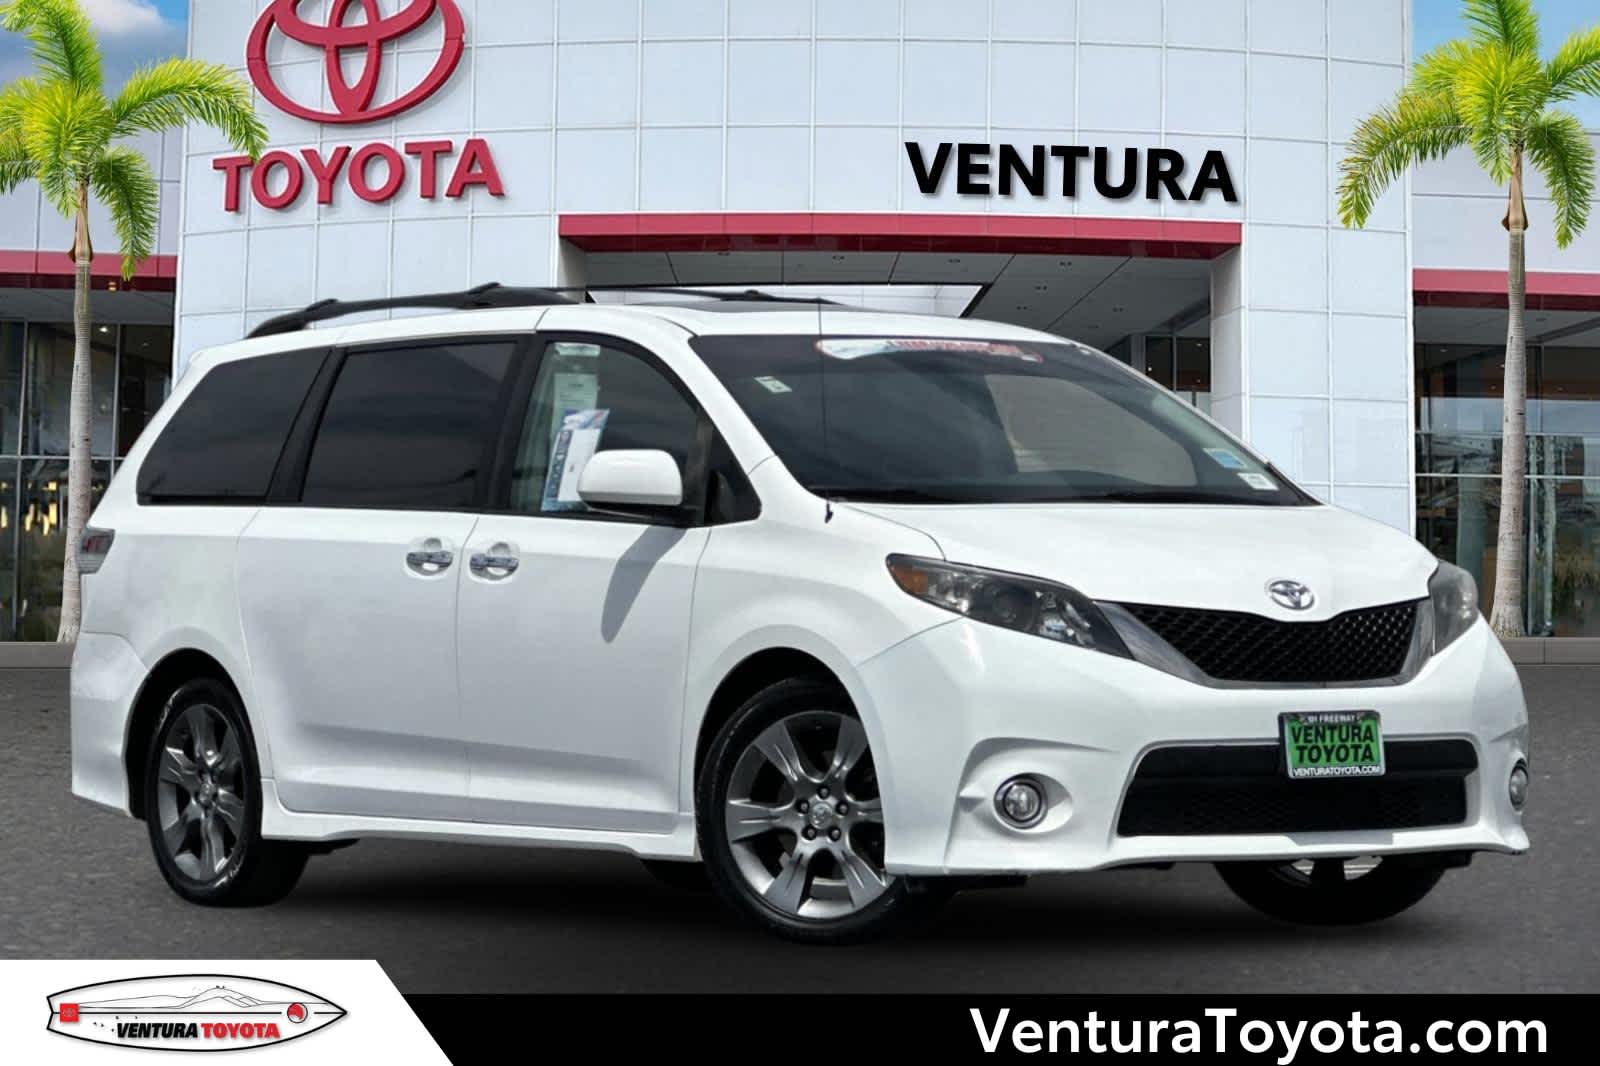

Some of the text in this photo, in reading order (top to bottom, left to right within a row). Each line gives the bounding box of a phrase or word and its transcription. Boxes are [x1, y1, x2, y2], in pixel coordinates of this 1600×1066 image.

[212, 138, 505, 212] TOYOTA
[905, 141, 1239, 203] VENTURA
[1291, 725, 1374, 743] VENTURA
[1296, 744, 1374, 763] TOYOTA
[1293, 766, 1380, 776] VENTURATOYOTA.COM
